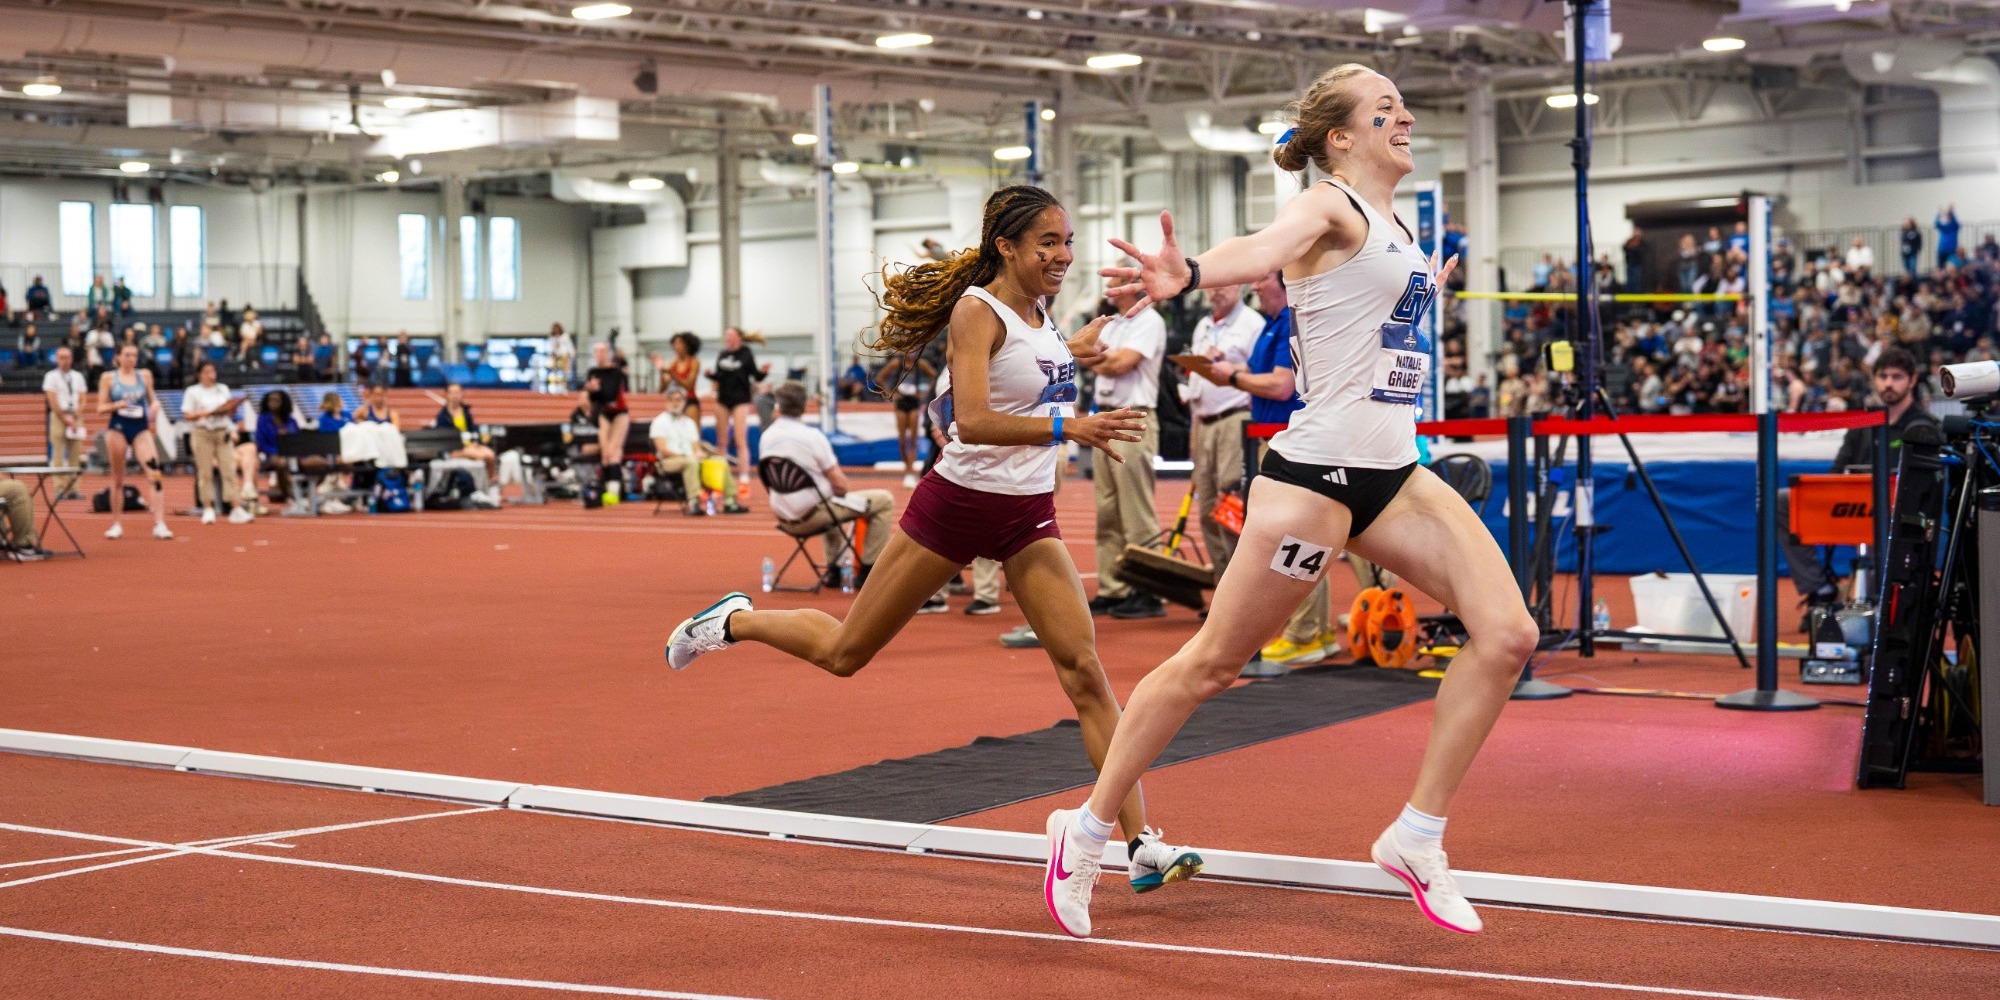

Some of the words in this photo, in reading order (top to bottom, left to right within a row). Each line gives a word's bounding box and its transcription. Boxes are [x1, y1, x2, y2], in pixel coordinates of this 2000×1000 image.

[1396, 355, 1422, 371] NATALIE
[1831, 503, 1873, 518] GIL
[1281, 543, 1325, 574] 14
